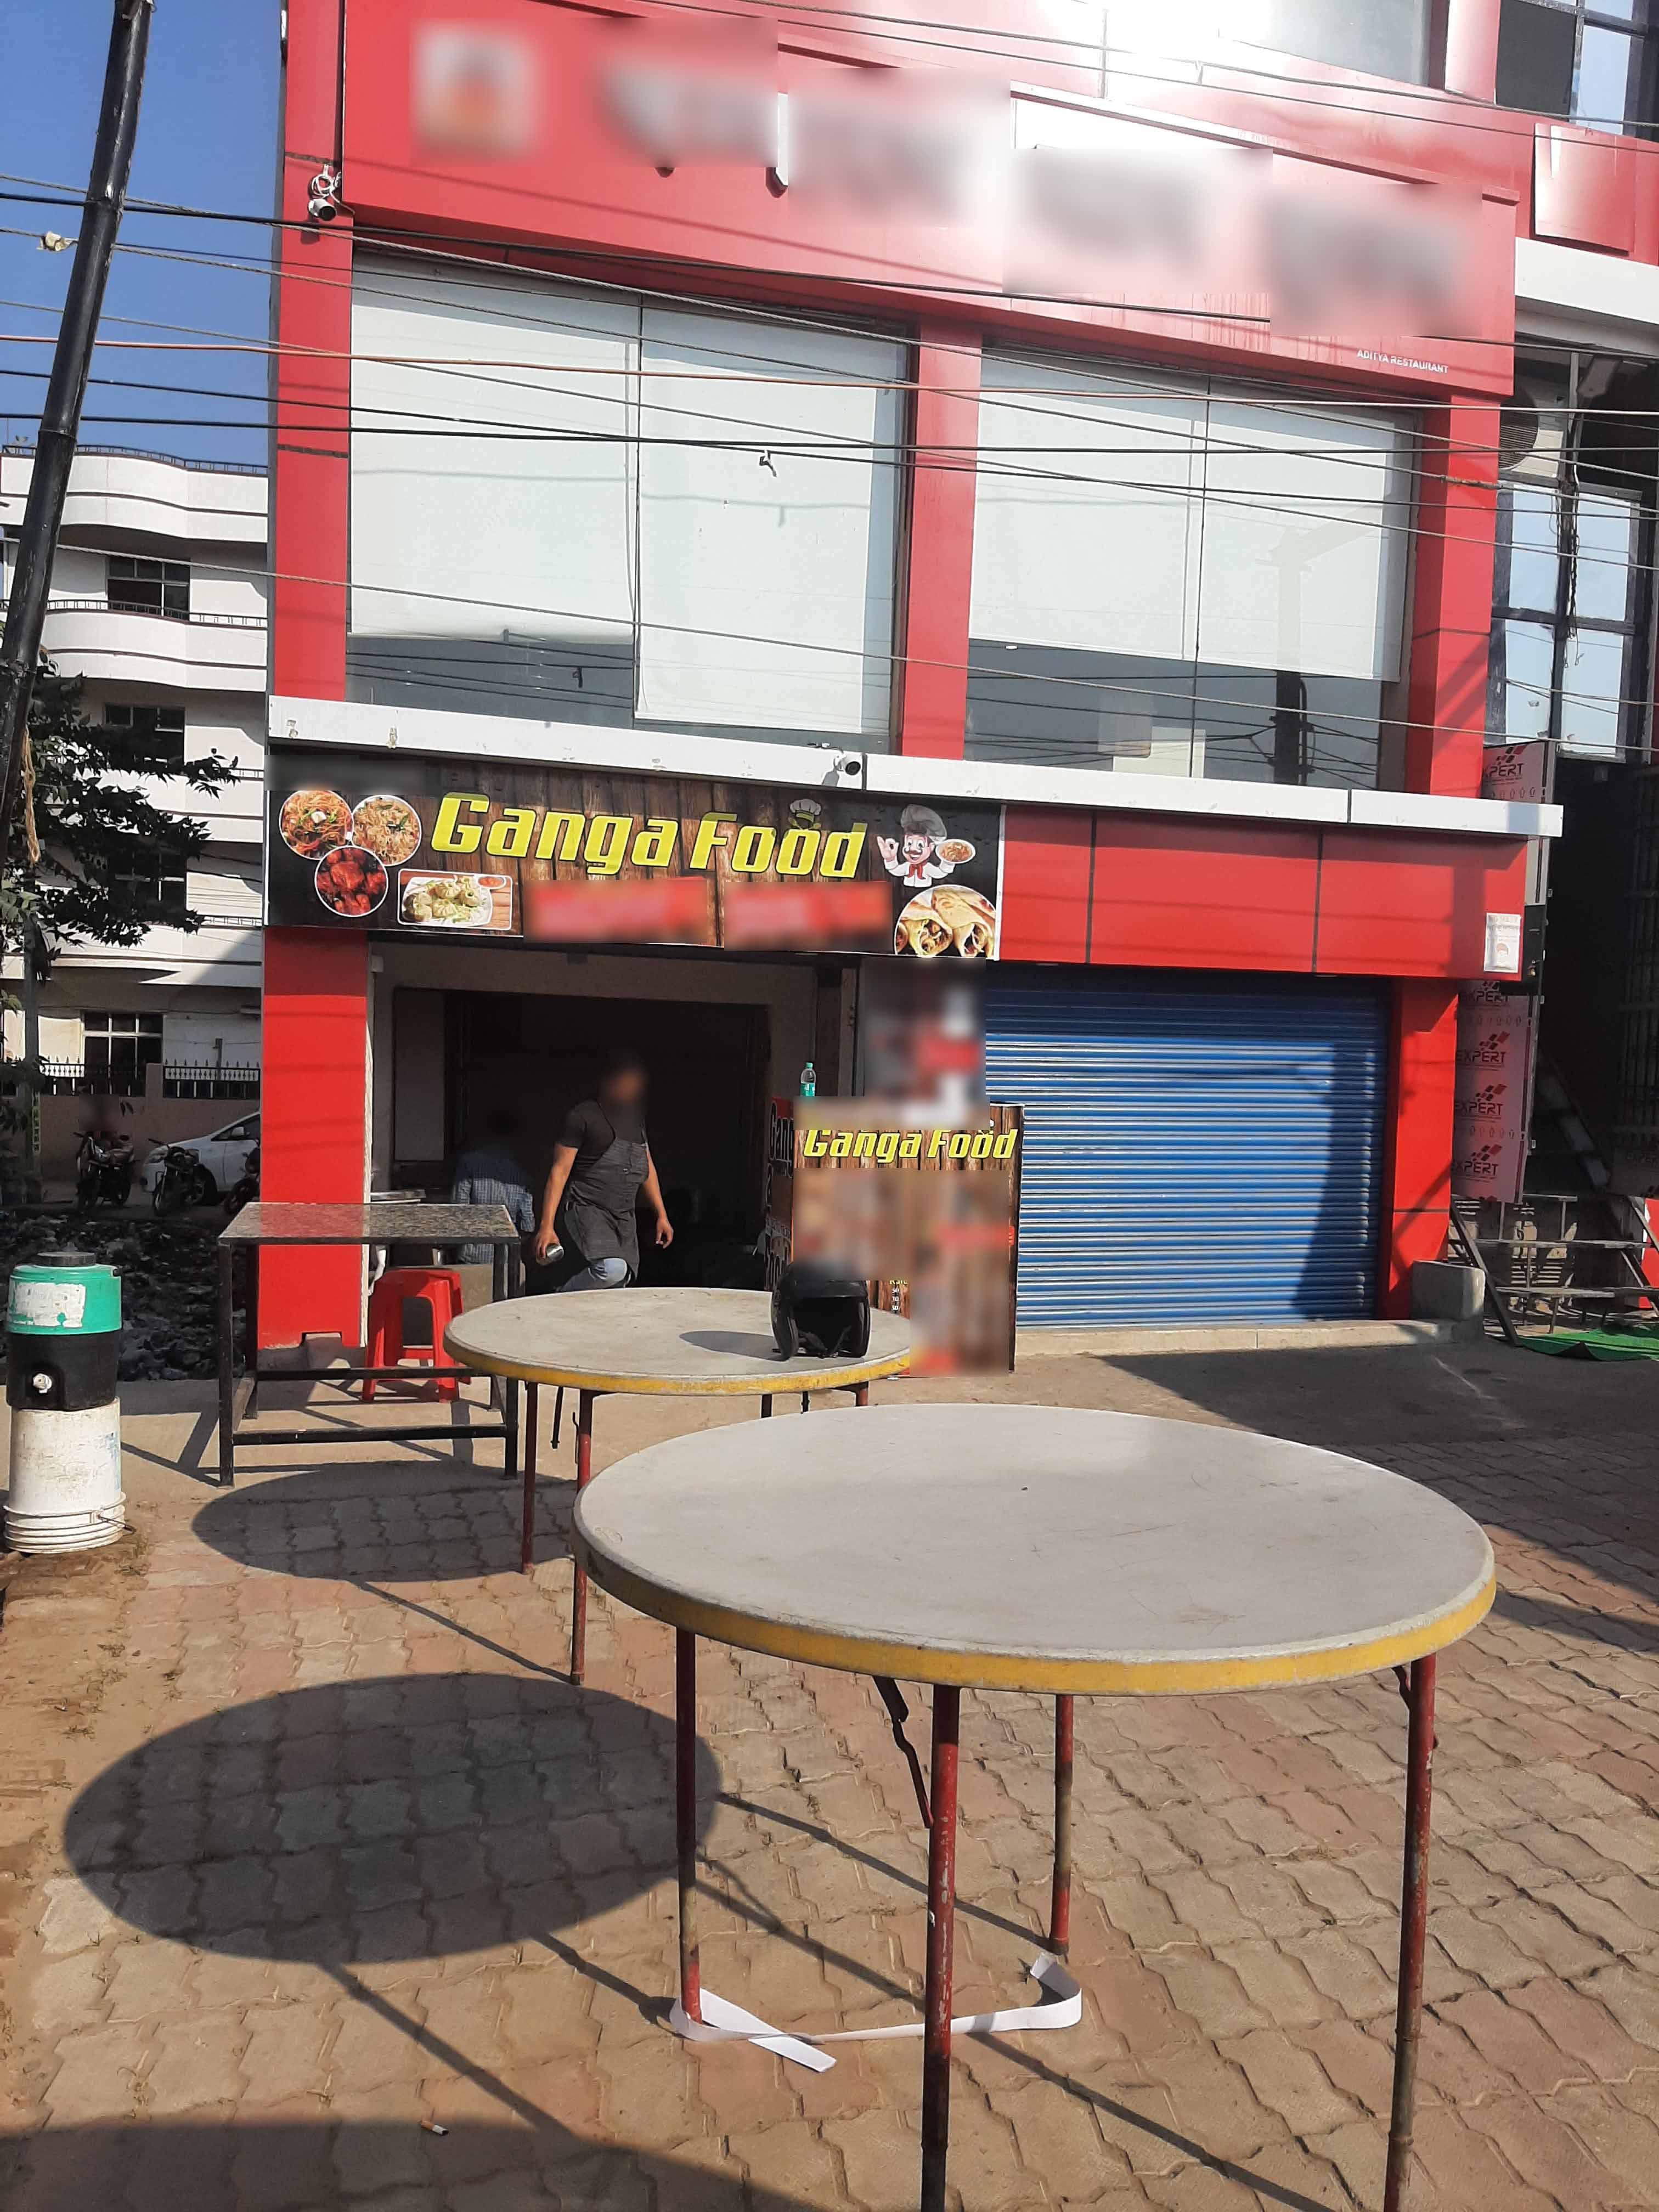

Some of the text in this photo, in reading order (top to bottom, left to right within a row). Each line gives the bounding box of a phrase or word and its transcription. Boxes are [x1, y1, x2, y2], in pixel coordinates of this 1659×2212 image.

[1357, 349, 1449, 374] ADITYA RESTAURANT
[431, 792, 868, 878] Ganga Food
[1457, 1048, 1506, 1063] EXPERT
[1454, 1101, 1504, 1115] EXPERT
[803, 1128, 1018, 1164] Ganga Food
